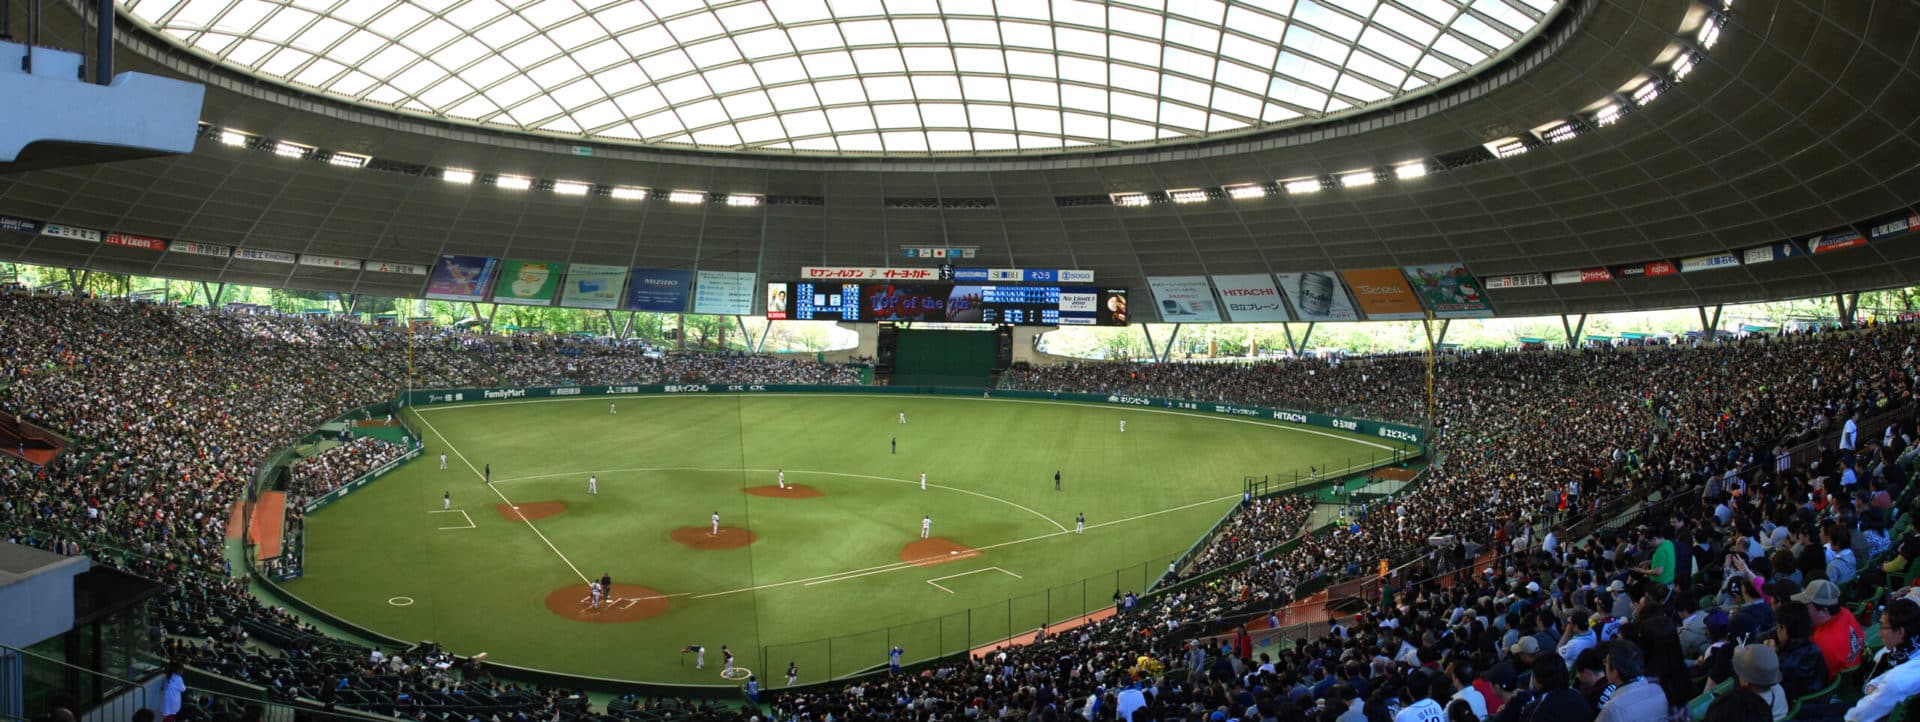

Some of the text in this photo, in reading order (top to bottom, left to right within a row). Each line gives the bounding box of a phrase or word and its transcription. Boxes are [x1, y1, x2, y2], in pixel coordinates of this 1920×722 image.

[121, 235, 151, 248] Vixen
[644, 278, 678, 286] MIZUHO
[1223, 288, 1274, 297] HITACHI
[903, 297, 918, 308] of
[921, 297, 943, 309] the
[484, 389, 525, 399] FamilyMart
[1273, 411, 1307, 423] HITACHI
